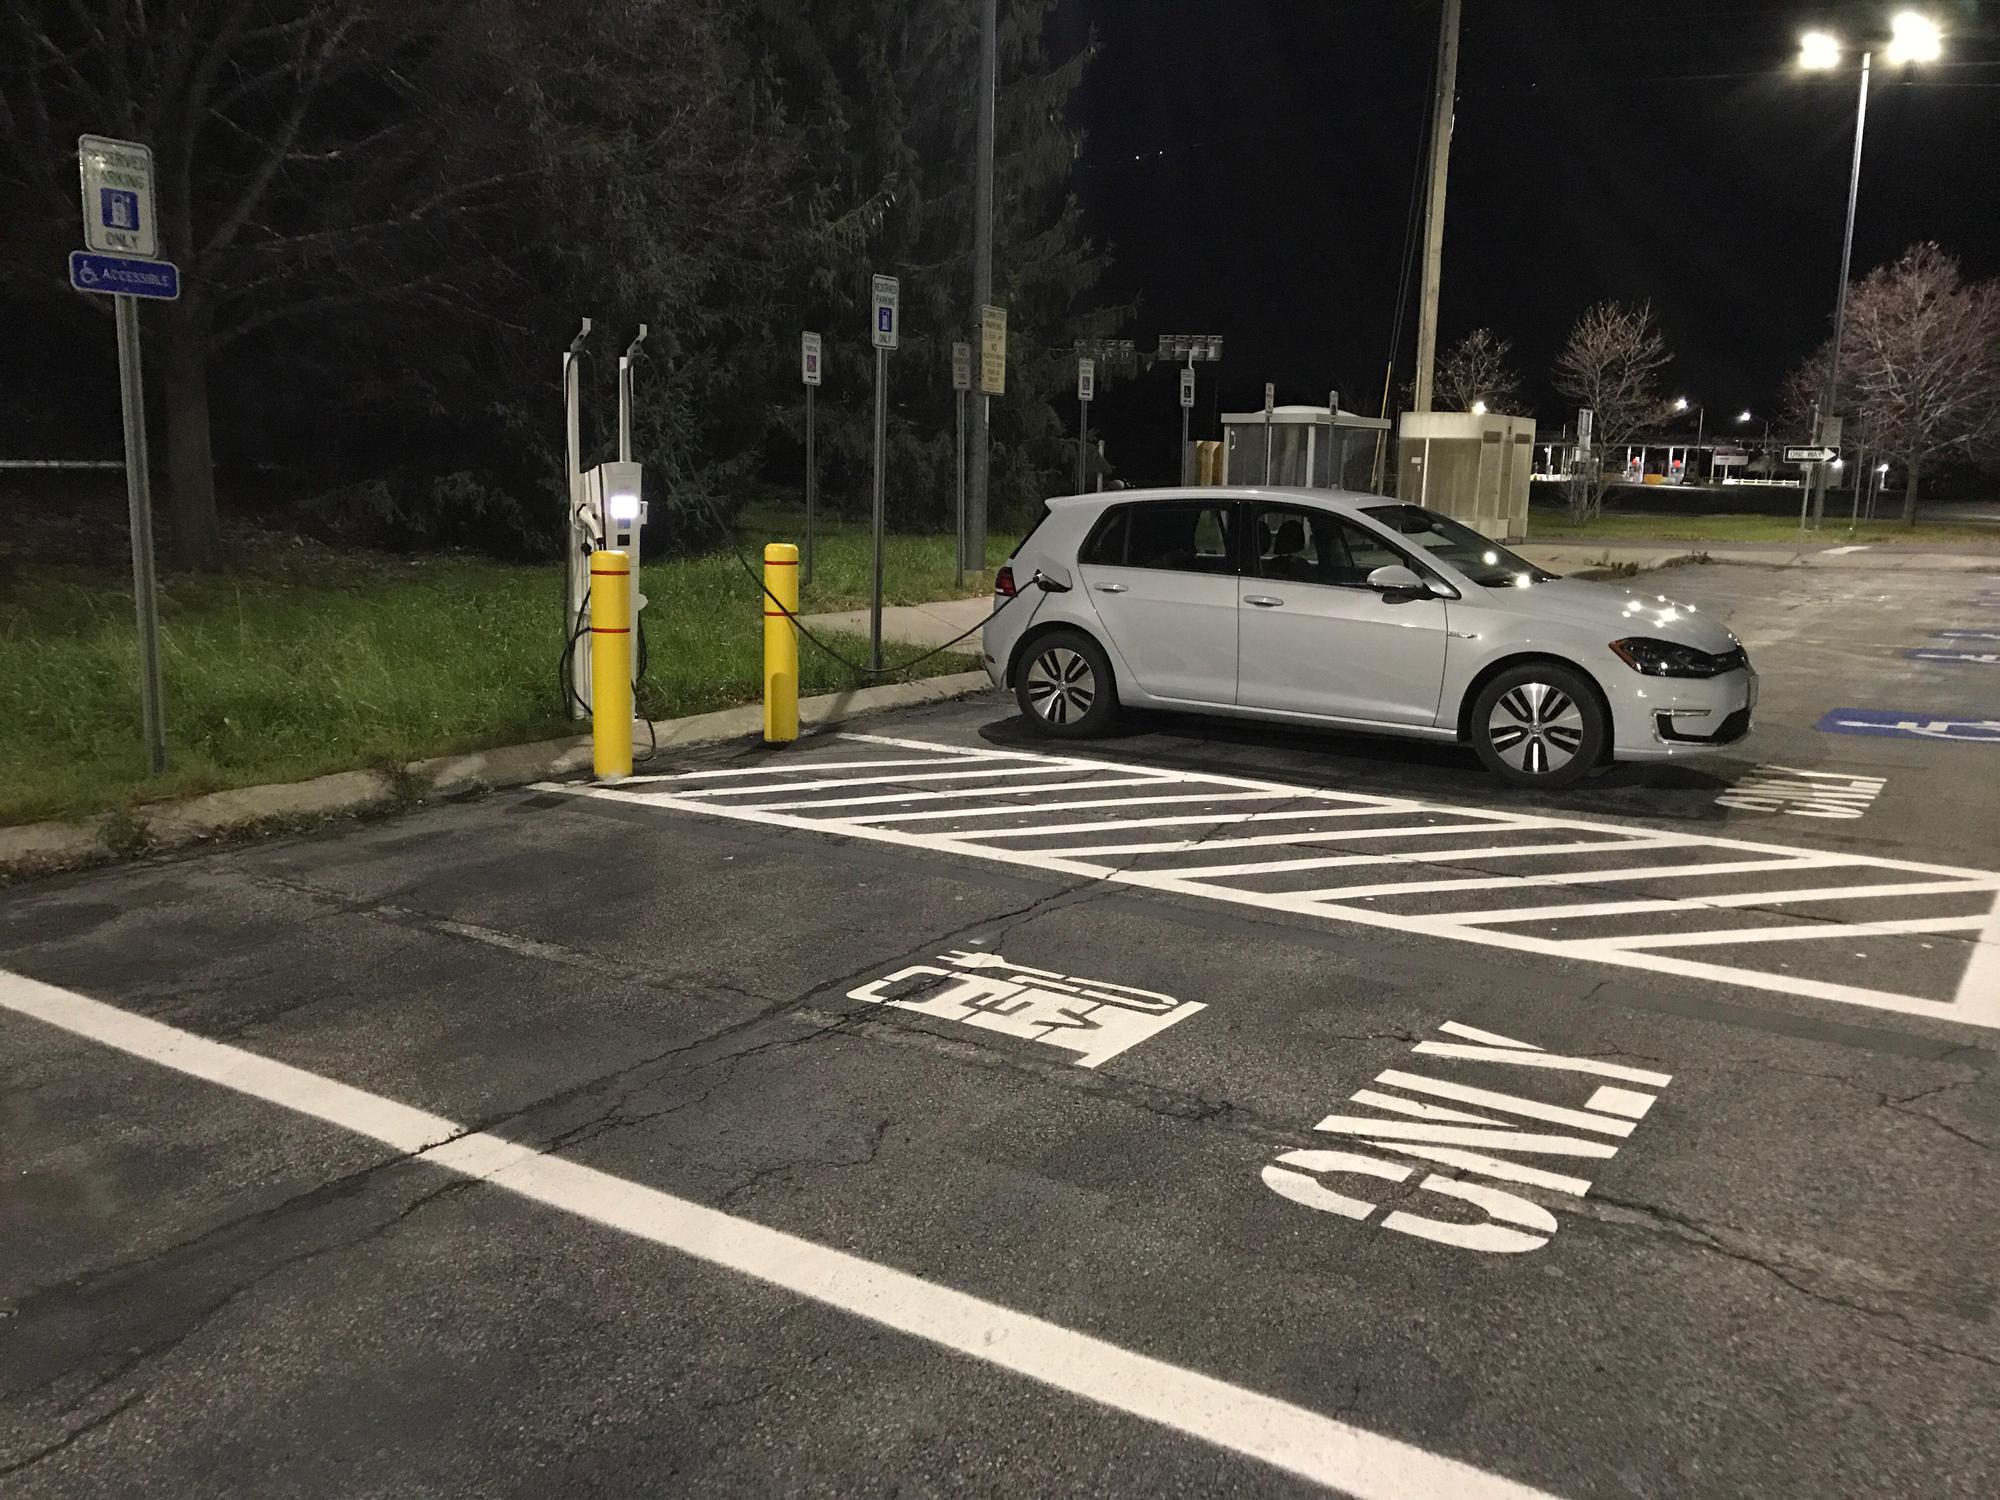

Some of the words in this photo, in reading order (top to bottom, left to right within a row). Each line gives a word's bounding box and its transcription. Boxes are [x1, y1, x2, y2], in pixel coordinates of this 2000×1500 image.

[106, 233, 139, 249] ONLY
[103, 268, 169, 286] ACCESSIBLE
[874, 282, 897, 295] RESERVED
[876, 294, 896, 306] PARKING
[879, 334, 891, 345] ONLY
[1807, 451, 1824, 459] WAY
[1714, 764, 1888, 819] ONLY
[1261, 1021, 1673, 1254] ONLY
